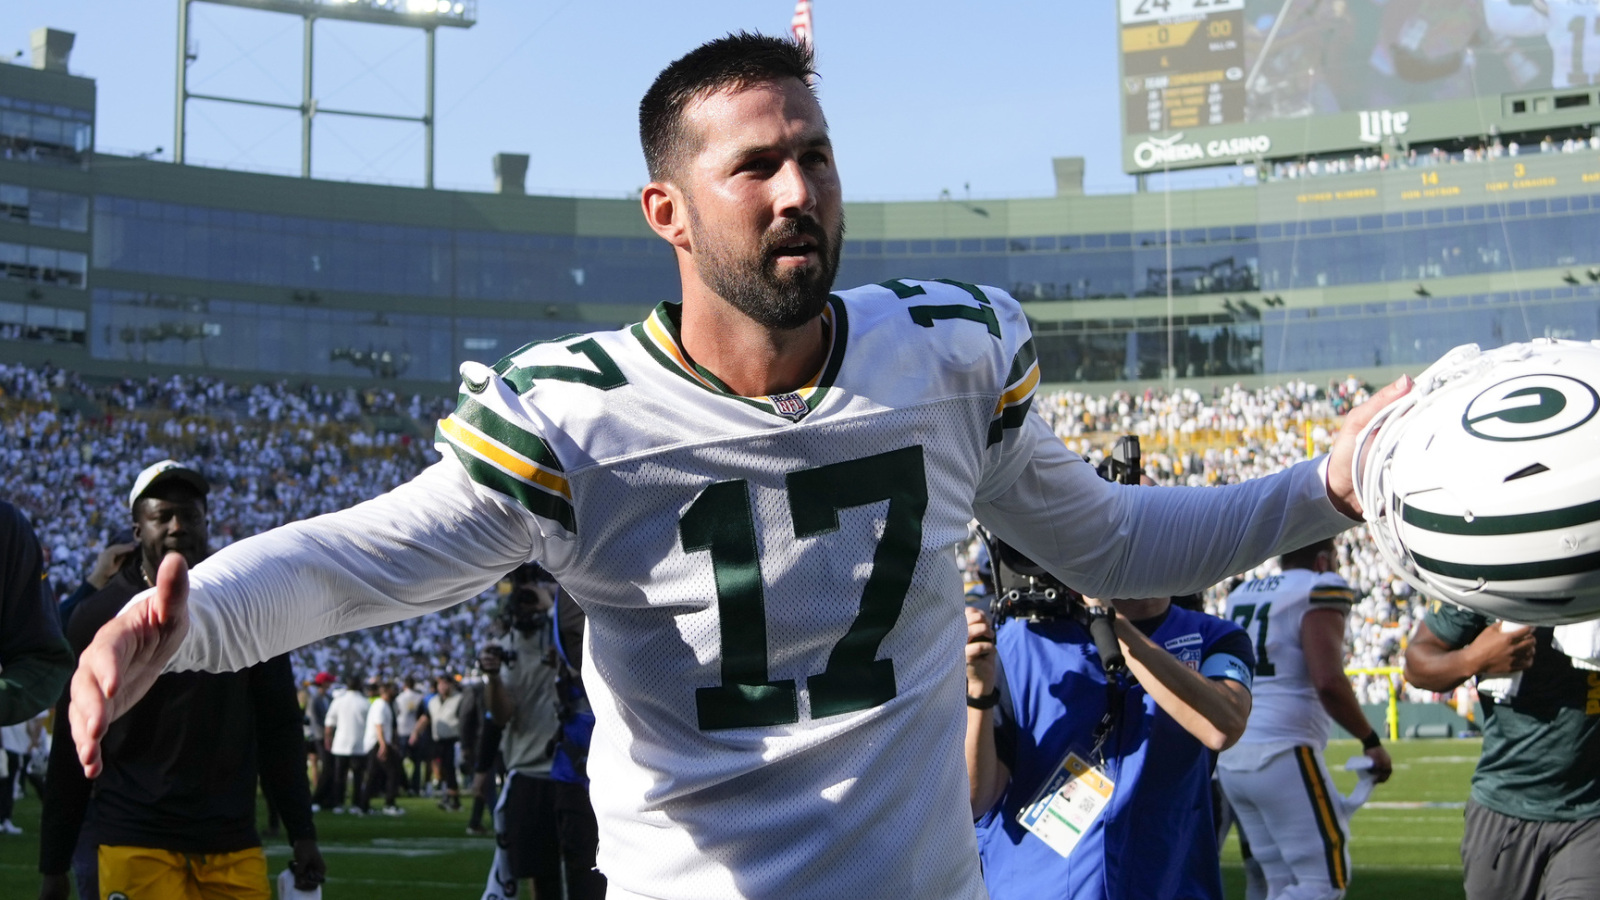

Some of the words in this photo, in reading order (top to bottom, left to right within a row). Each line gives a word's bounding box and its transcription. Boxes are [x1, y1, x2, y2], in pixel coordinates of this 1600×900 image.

[1358, 110, 1409, 143] Lite
[1134, 140, 1204, 168] ONEIDA
[1206, 134, 1270, 158] CASINO
[1420, 170, 1439, 186] 14
[1513, 162, 1526, 178] 3
[779, 400, 804, 412] NFL
[679, 445, 928, 730] 17
[1231, 602, 1275, 676] 71
